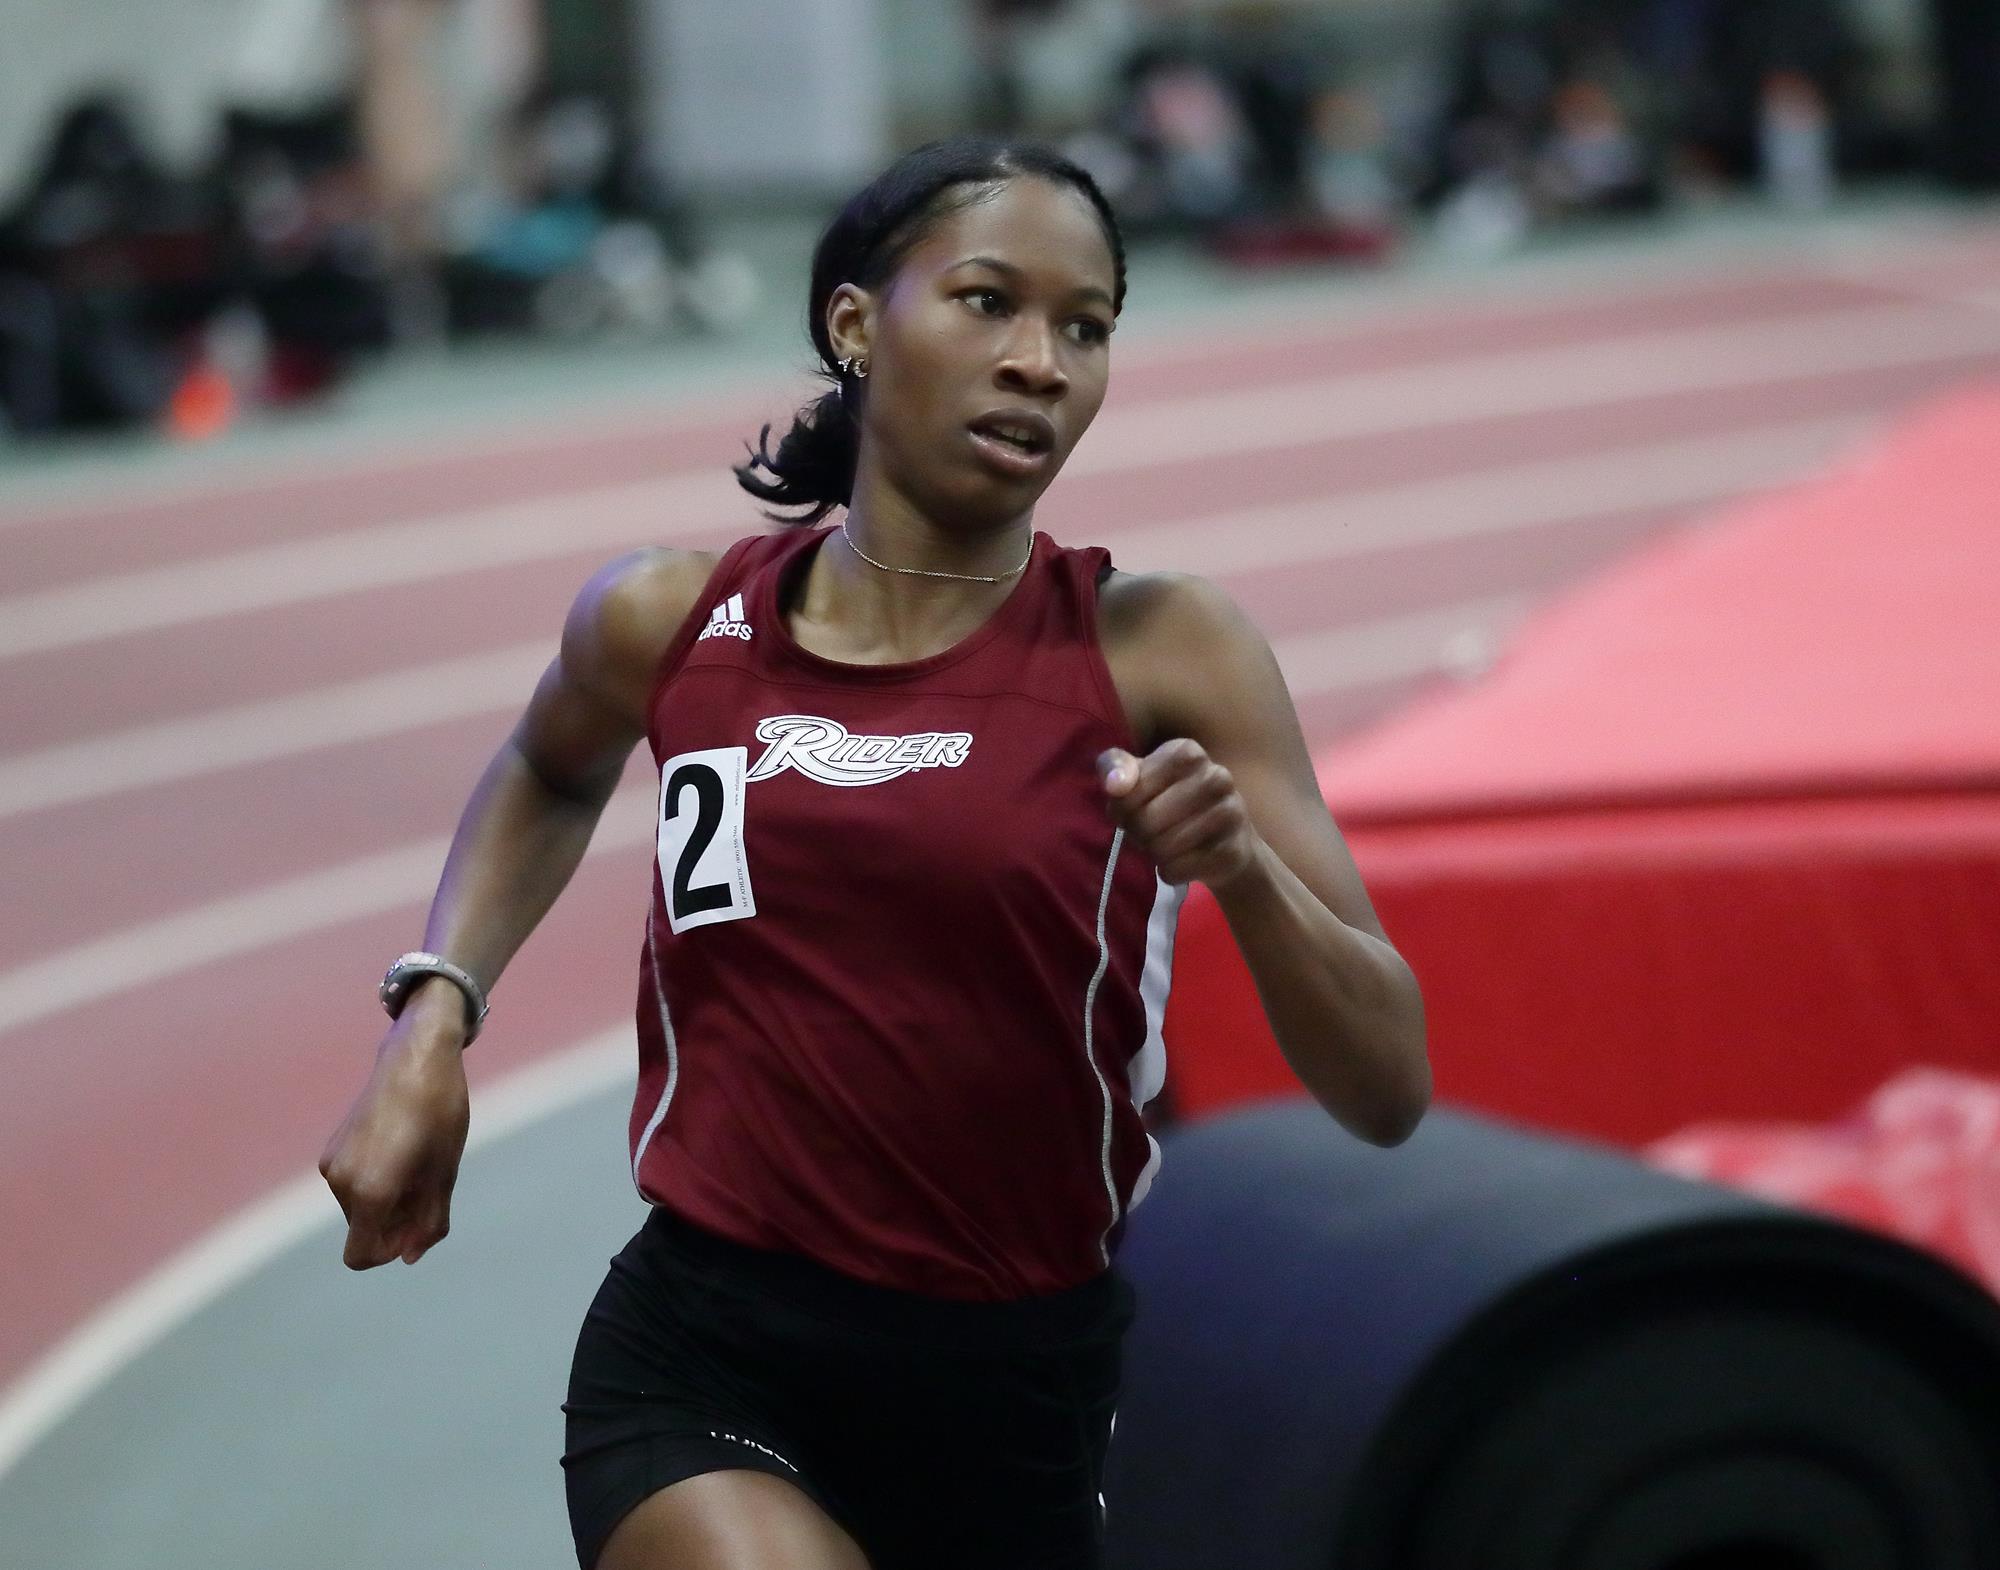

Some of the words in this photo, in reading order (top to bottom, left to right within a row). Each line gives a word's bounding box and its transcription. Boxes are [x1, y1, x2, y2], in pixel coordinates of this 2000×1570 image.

[698, 618, 753, 641] didas
[746, 714, 973, 787] RIDER
[664, 763, 733, 921] 2
[737, 866, 746, 896] ATHLETIC
